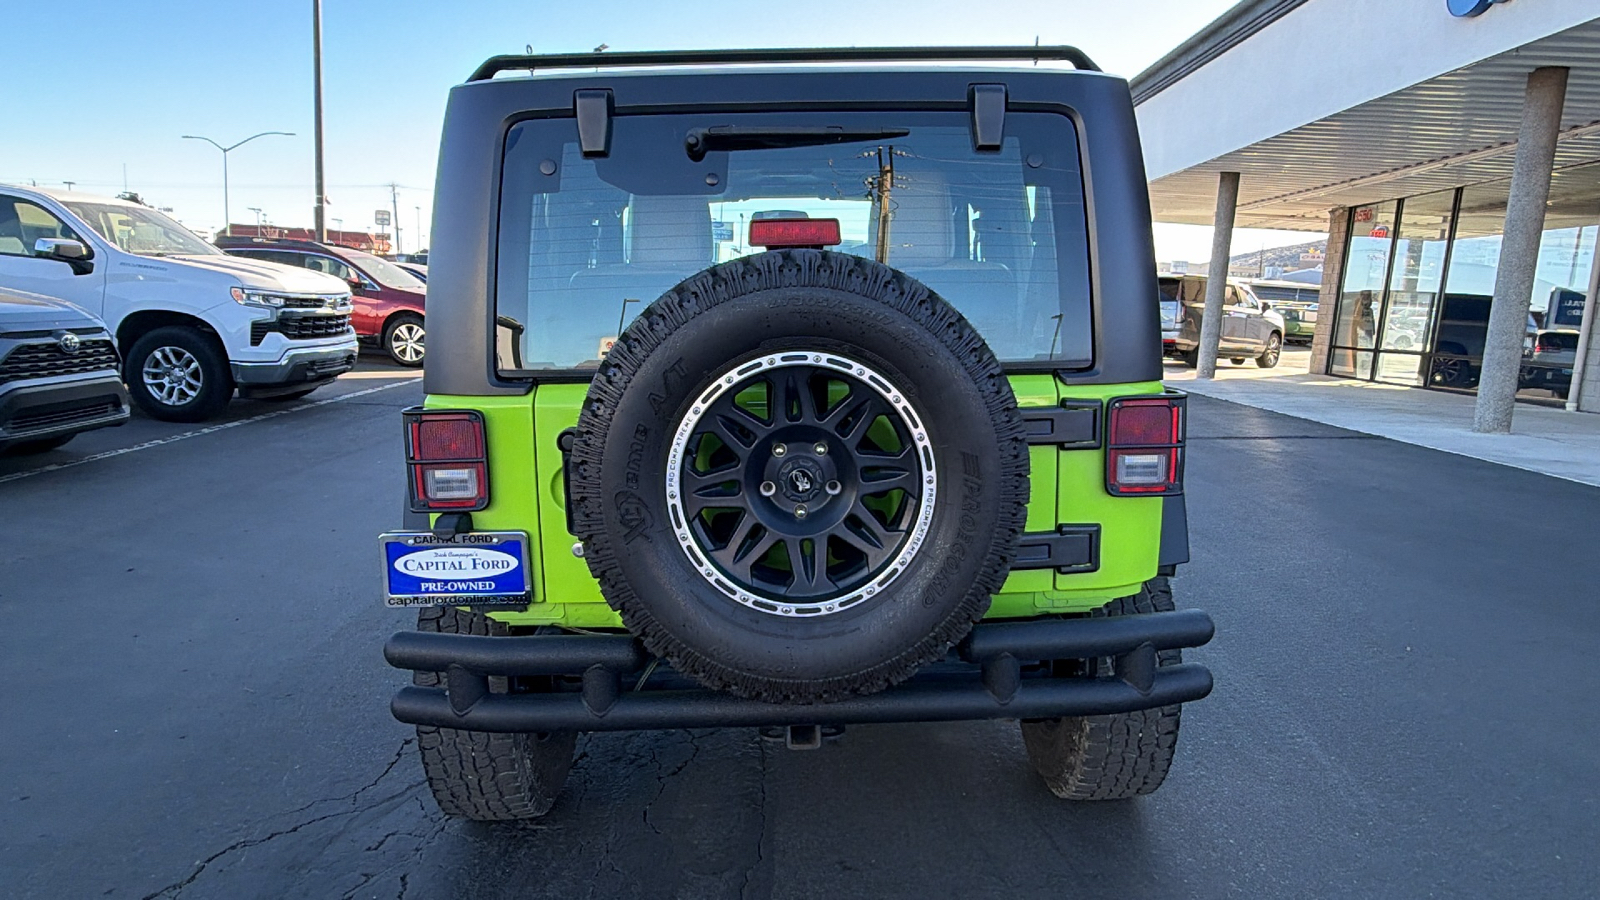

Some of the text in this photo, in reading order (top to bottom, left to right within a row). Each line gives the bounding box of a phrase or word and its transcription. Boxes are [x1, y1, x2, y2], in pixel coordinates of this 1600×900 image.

[669, 448, 679, 471] COMP
[675, 416, 693, 448] XTREME
[906, 487, 934, 557] PRO COMP XTREME
[462, 535, 493, 544] FORD
[403, 557, 511, 572] CAPITAL FORD
[420, 581, 496, 592] PRE-OWNED
[387, 594, 528, 608] capitalfordonline.com
